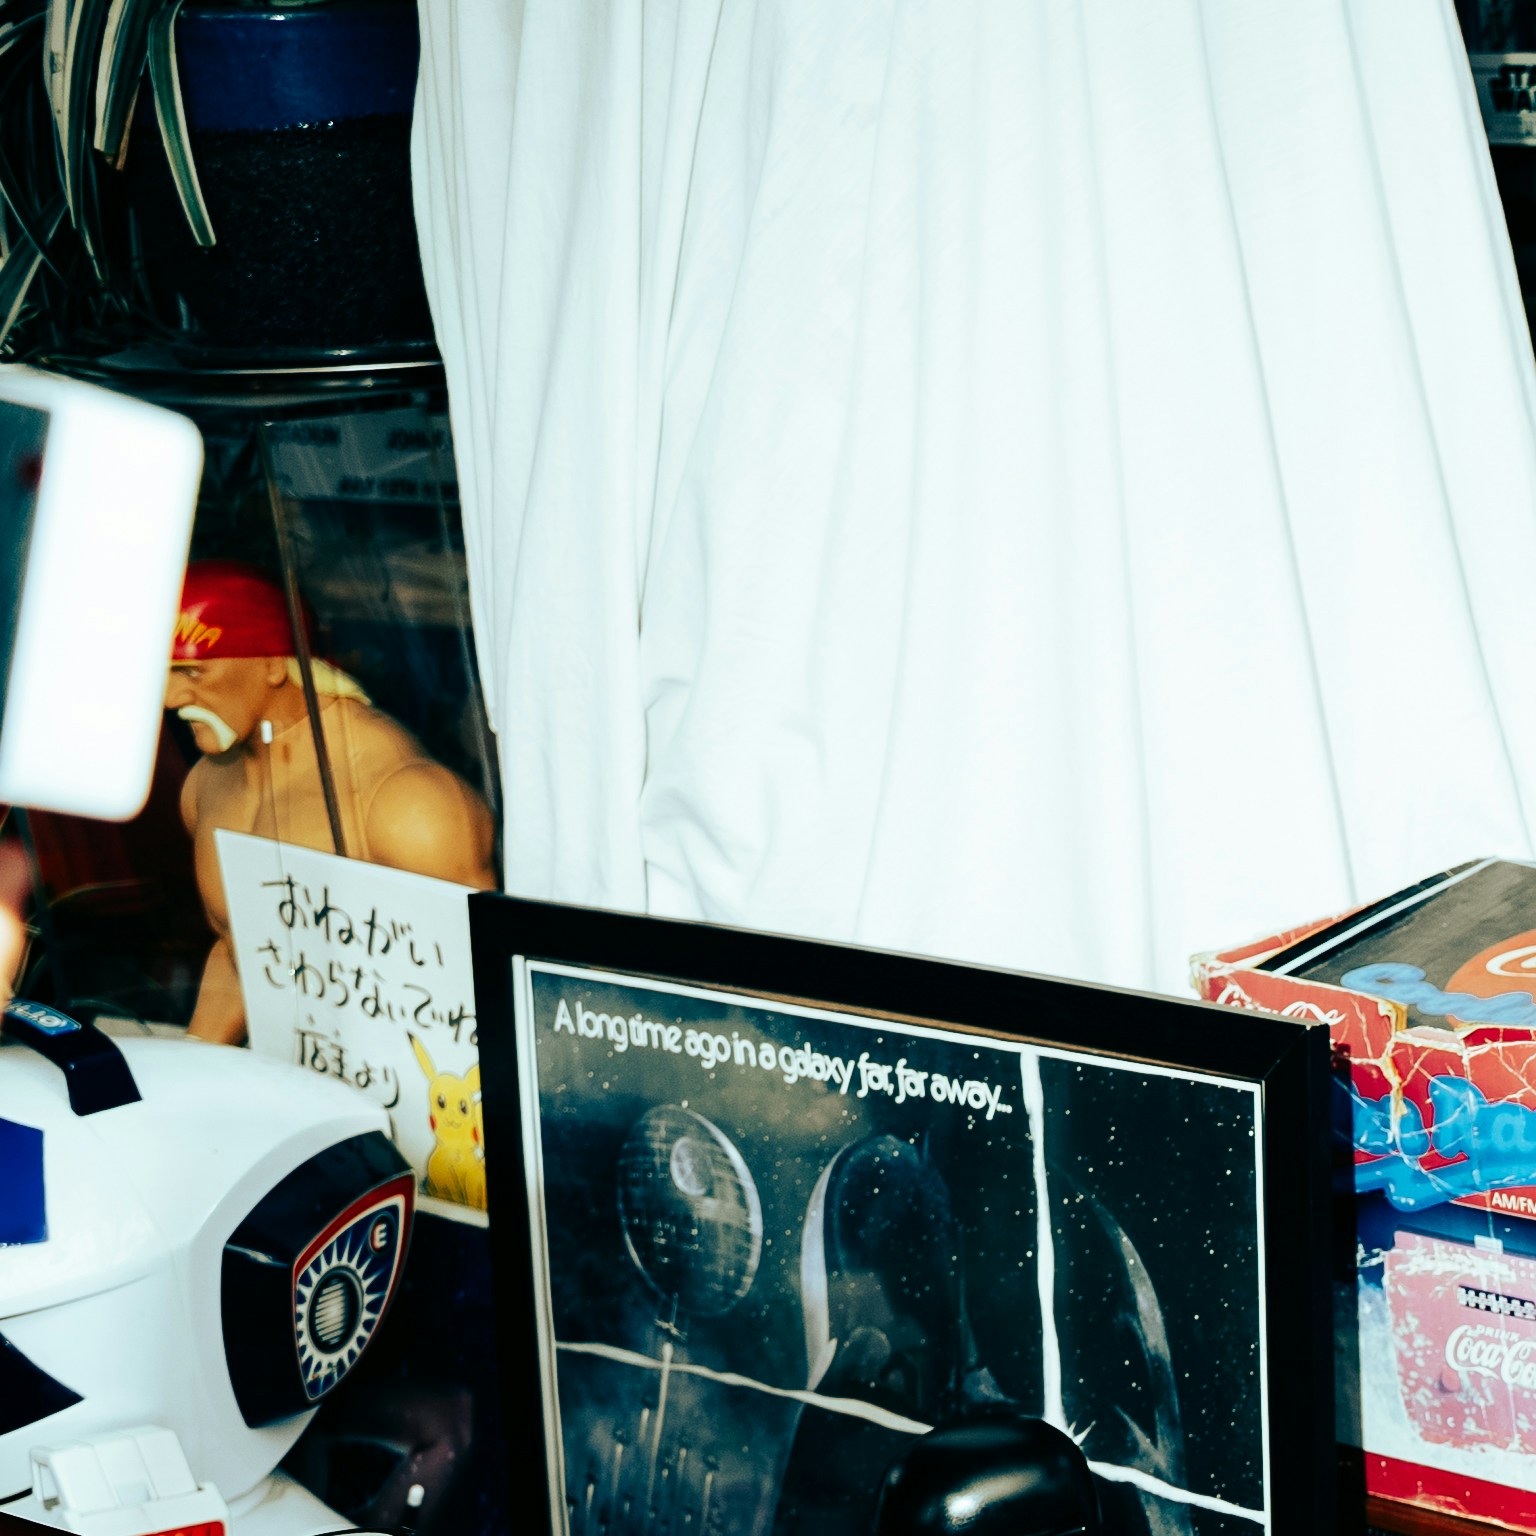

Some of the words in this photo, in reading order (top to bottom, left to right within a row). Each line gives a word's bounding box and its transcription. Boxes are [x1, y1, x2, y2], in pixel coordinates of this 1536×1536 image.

[262, 873, 444, 968] おねがい
[553, 998, 576, 1034] A
[575, 1001, 629, 1052] long
[628, 1013, 682, 1055] time
[684, 1029, 731, 1069] ago
[731, 1032, 757, 1067] in
[759, 1043, 778, 1071] a
[779, 1041, 856, 1095] galaxy
[855, 1052, 895, 1099] far,
[894, 1058, 929, 1104] far
[930, 1072, 1014, 1121] away...
